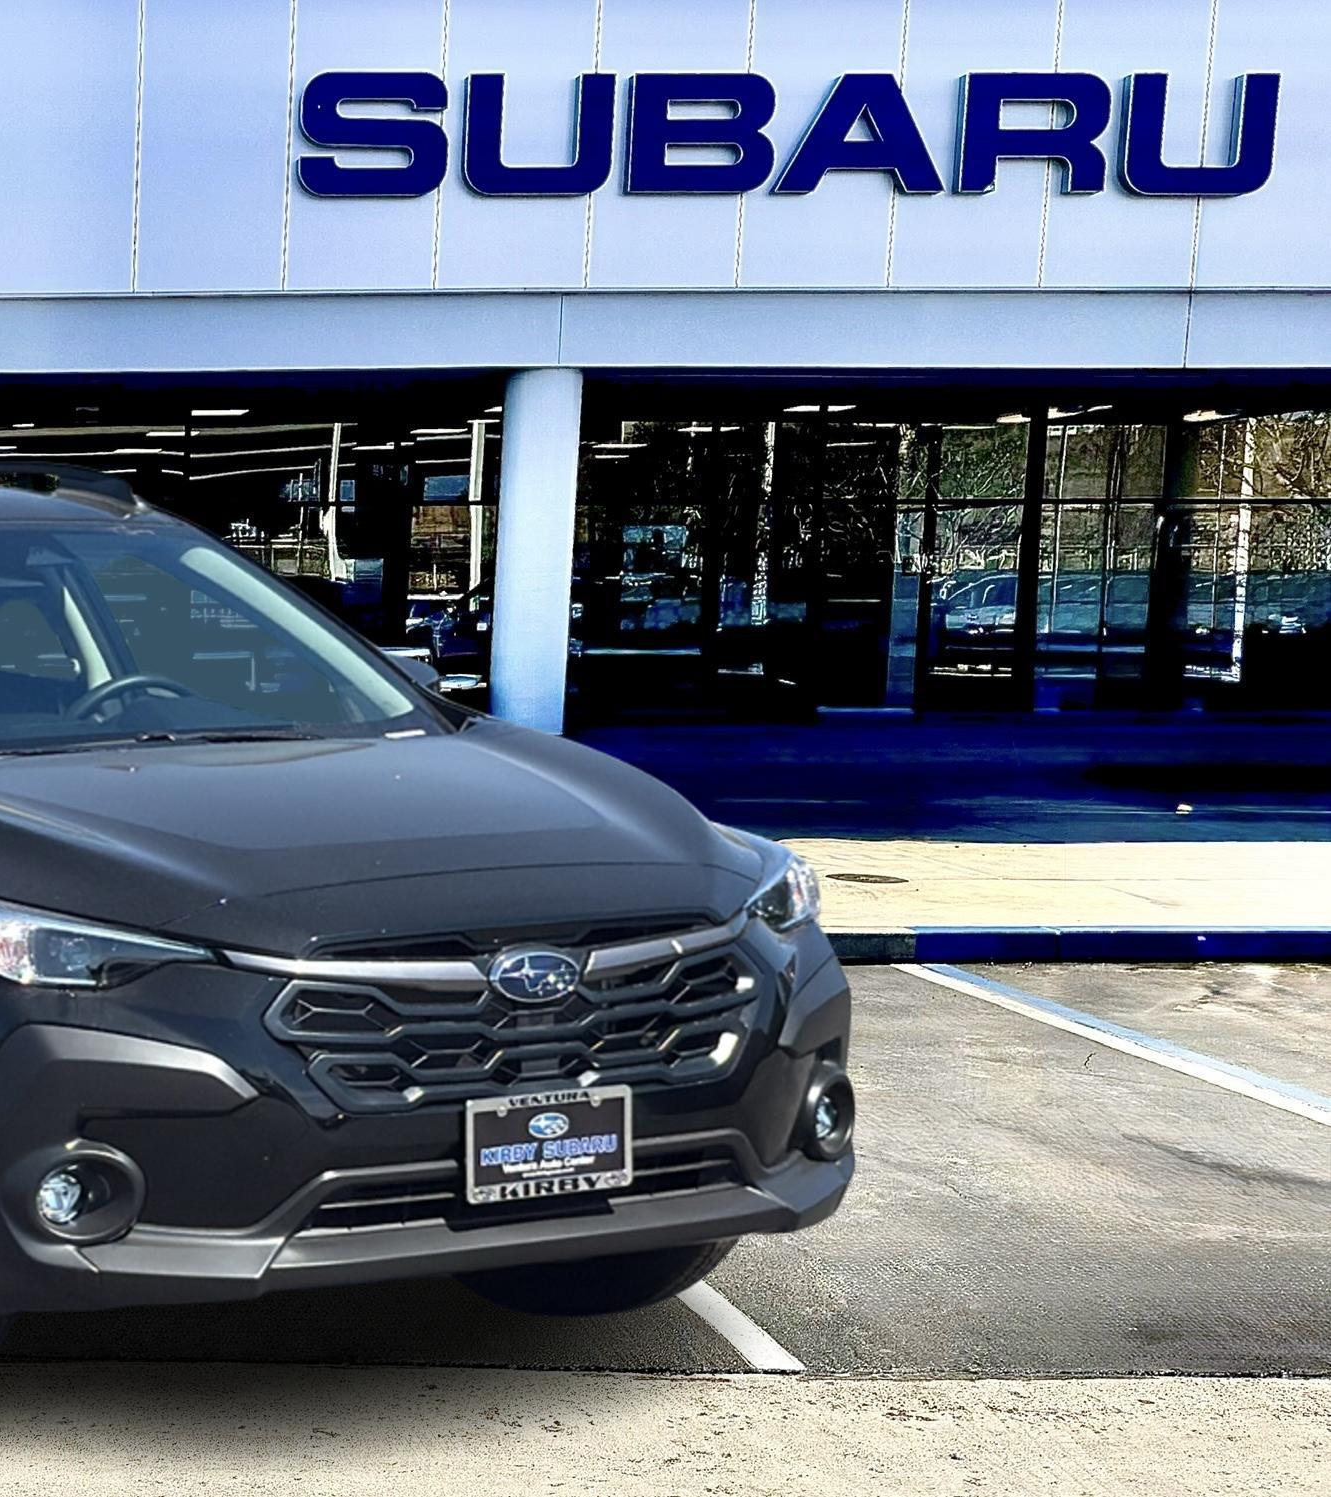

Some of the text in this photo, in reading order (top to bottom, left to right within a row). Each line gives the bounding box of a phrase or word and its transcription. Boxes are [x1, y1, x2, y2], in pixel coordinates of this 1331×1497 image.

[295, 70, 1281, 198] SUBARU
[509, 1091, 590, 1107] VENTURA
[481, 1134, 617, 1166] KIRBY SUBARU
[500, 1176, 601, 1199] KIRBY
